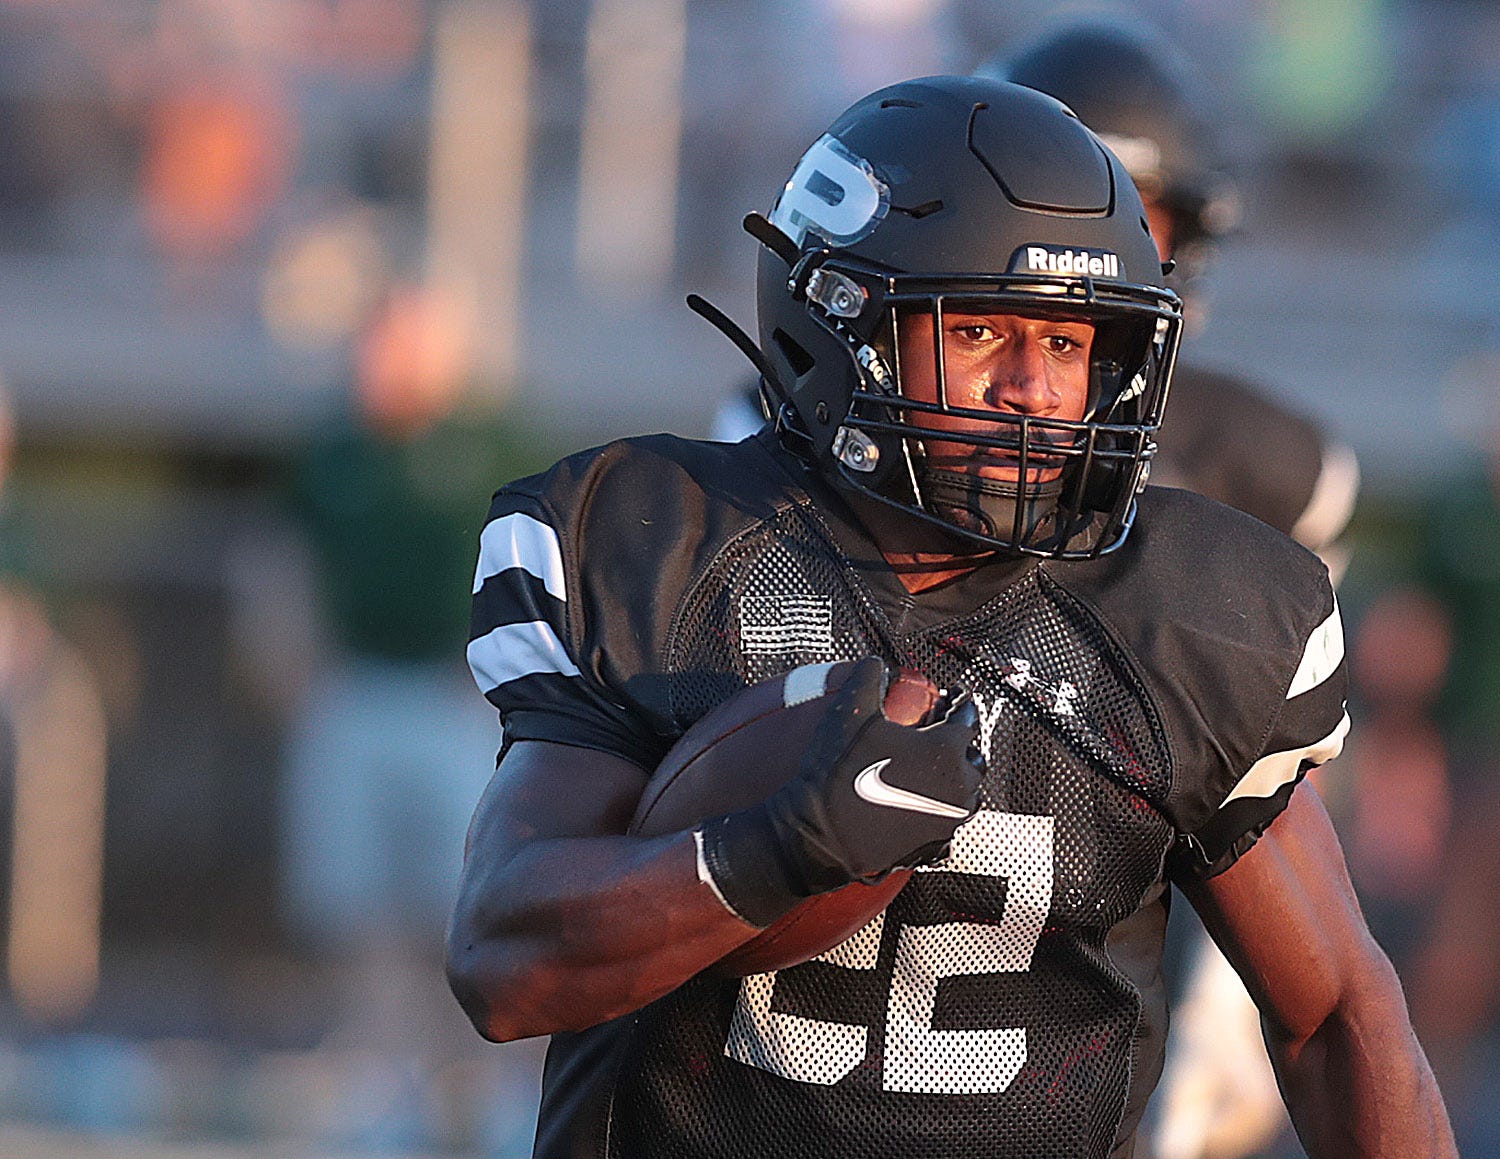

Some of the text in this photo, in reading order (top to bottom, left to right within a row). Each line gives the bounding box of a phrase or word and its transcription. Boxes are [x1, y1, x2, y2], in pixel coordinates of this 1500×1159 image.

[768, 133, 880, 249] P
[1026, 246, 1118, 277] Riddell
[724, 810, 1055, 1095] 22
